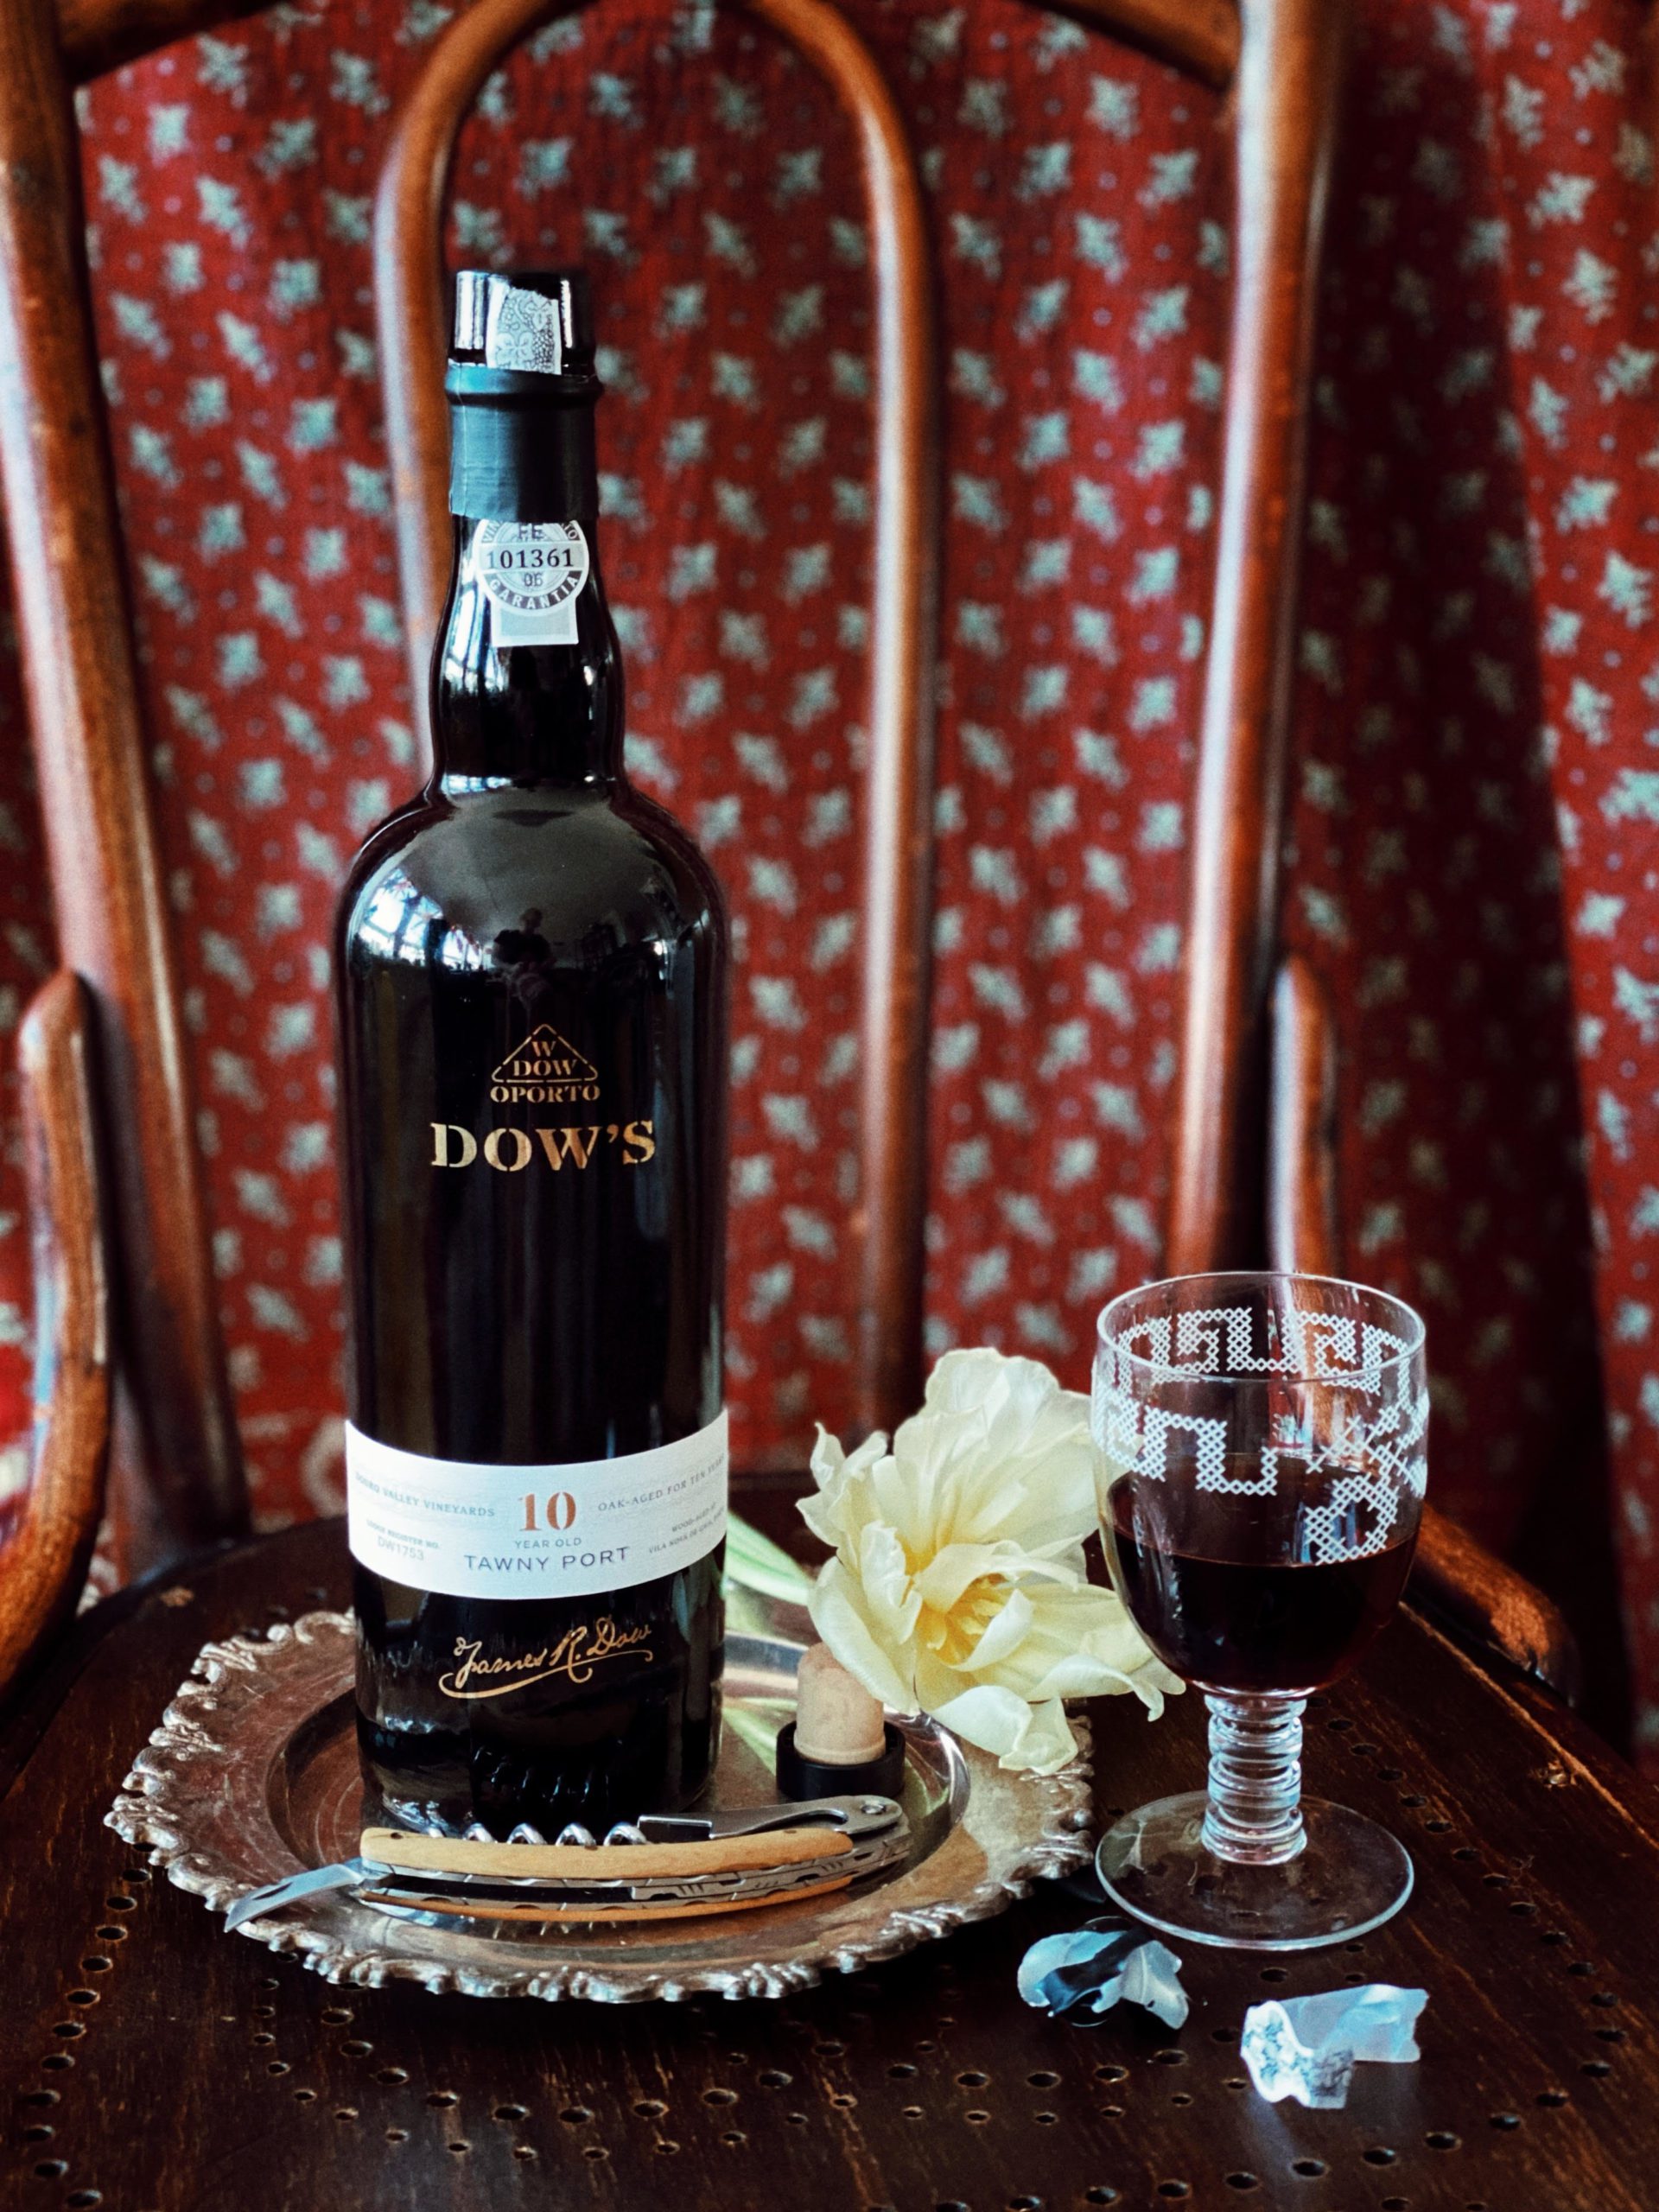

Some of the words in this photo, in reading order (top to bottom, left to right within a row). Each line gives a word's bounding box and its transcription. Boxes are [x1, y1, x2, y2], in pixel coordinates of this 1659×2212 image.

[487, 548, 574, 569] 101361
[490, 575, 579, 609] GARANTIA
[532, 1040, 556, 1058] W
[513, 1059, 578, 1077] DOW
[490, 1084, 601, 1103] OPORTO
[430, 1120, 656, 1173] DOW'S
[382, 1486, 420, 1506] VALLEY
[423, 1499, 496, 1517] VINEYARDS
[598, 1490, 664, 1511] OAK-AGED
[666, 1479, 687, 1495] FOR
[690, 1471, 706, 1485] TEN
[518, 1491, 576, 1531] 10
[378, 1535, 424, 1561] DW1753
[514, 1540, 550, 1549] YEAR
[555, 1537, 582, 1548] OLD
[465, 1554, 550, 1571] TAWNY
[563, 1546, 630, 1569] PORT
[448, 1637, 549, 1694] James
[587, 1615, 652, 1656] Dow
